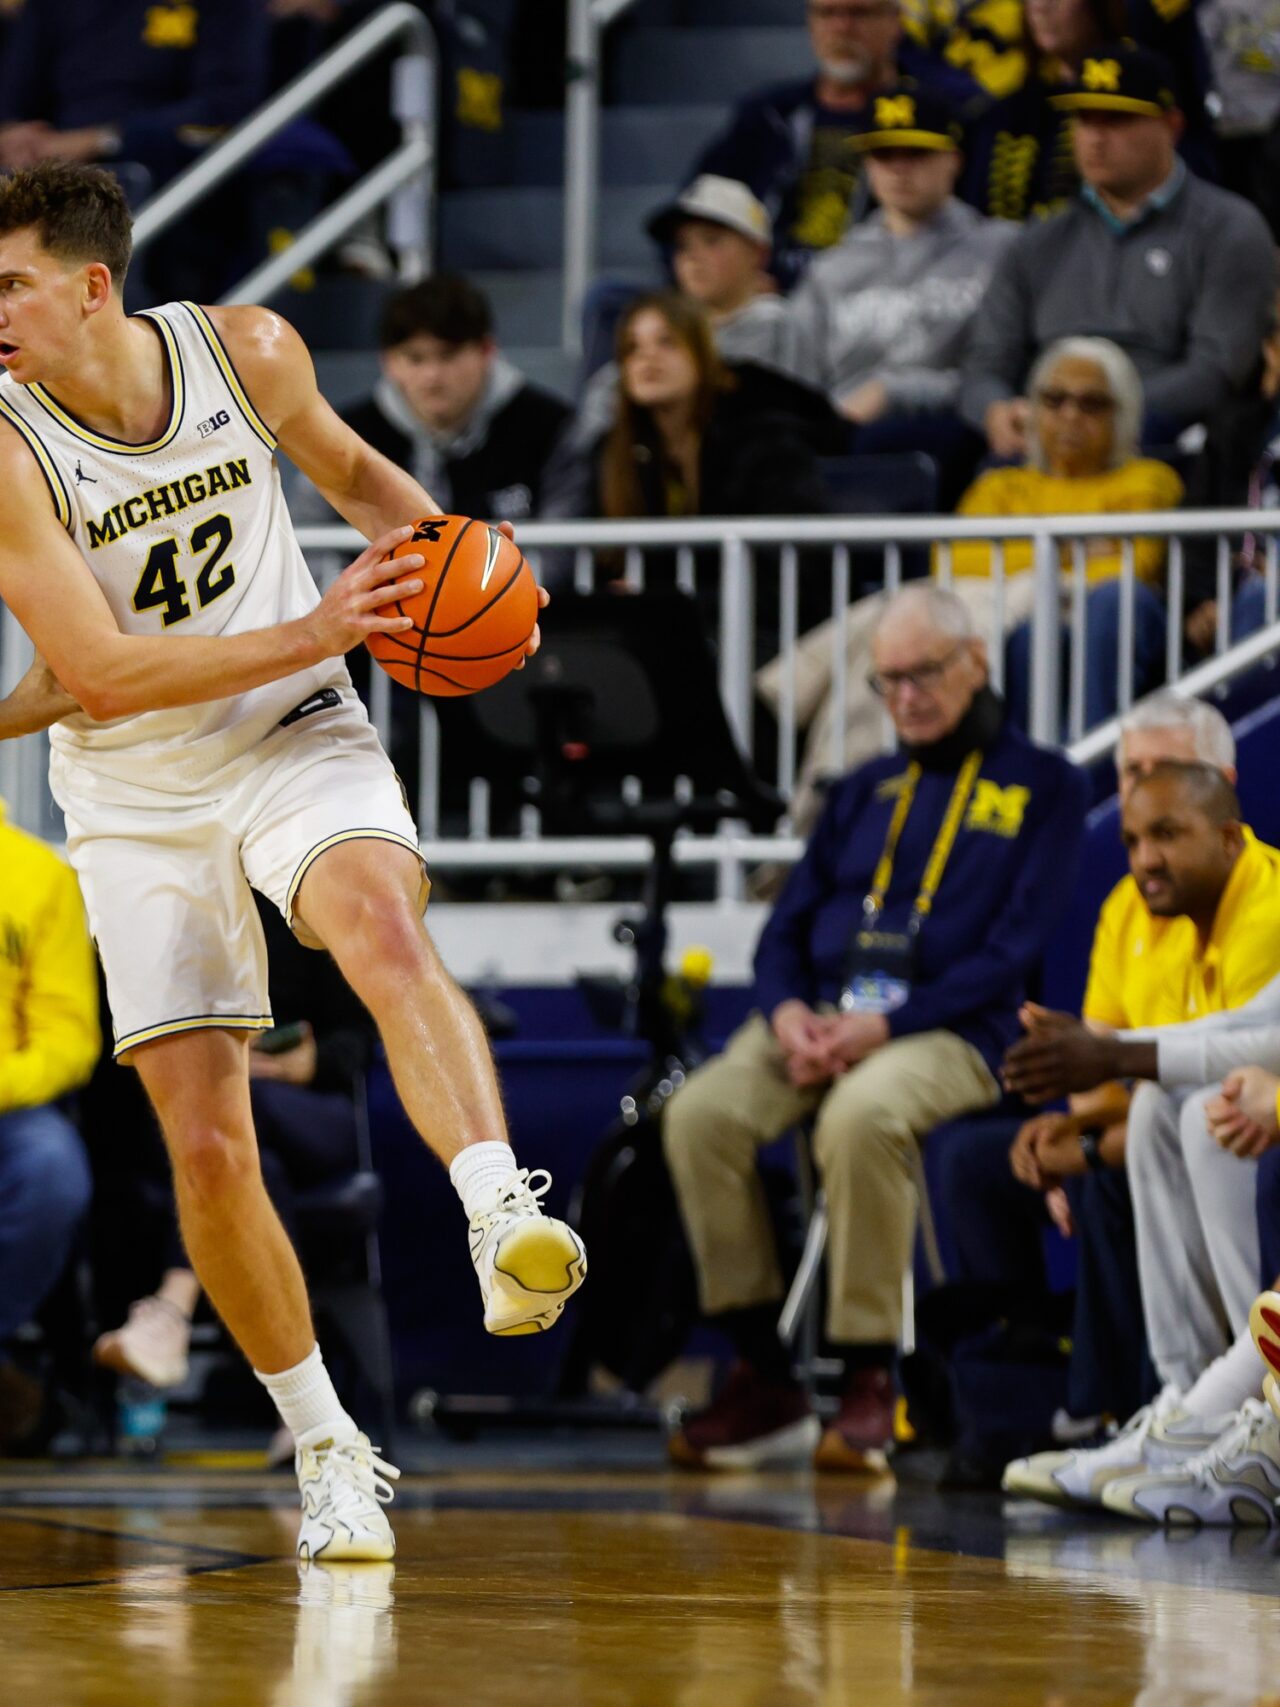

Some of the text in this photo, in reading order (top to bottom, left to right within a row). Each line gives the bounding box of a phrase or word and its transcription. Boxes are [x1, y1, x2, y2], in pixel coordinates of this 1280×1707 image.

[1082, 58, 1121, 91] M
[874, 95, 917, 128] M
[86, 458, 252, 549] MICHIGAN
[411, 520, 449, 543] M
[132, 513, 236, 630] 42
[969, 778, 1031, 834] M
